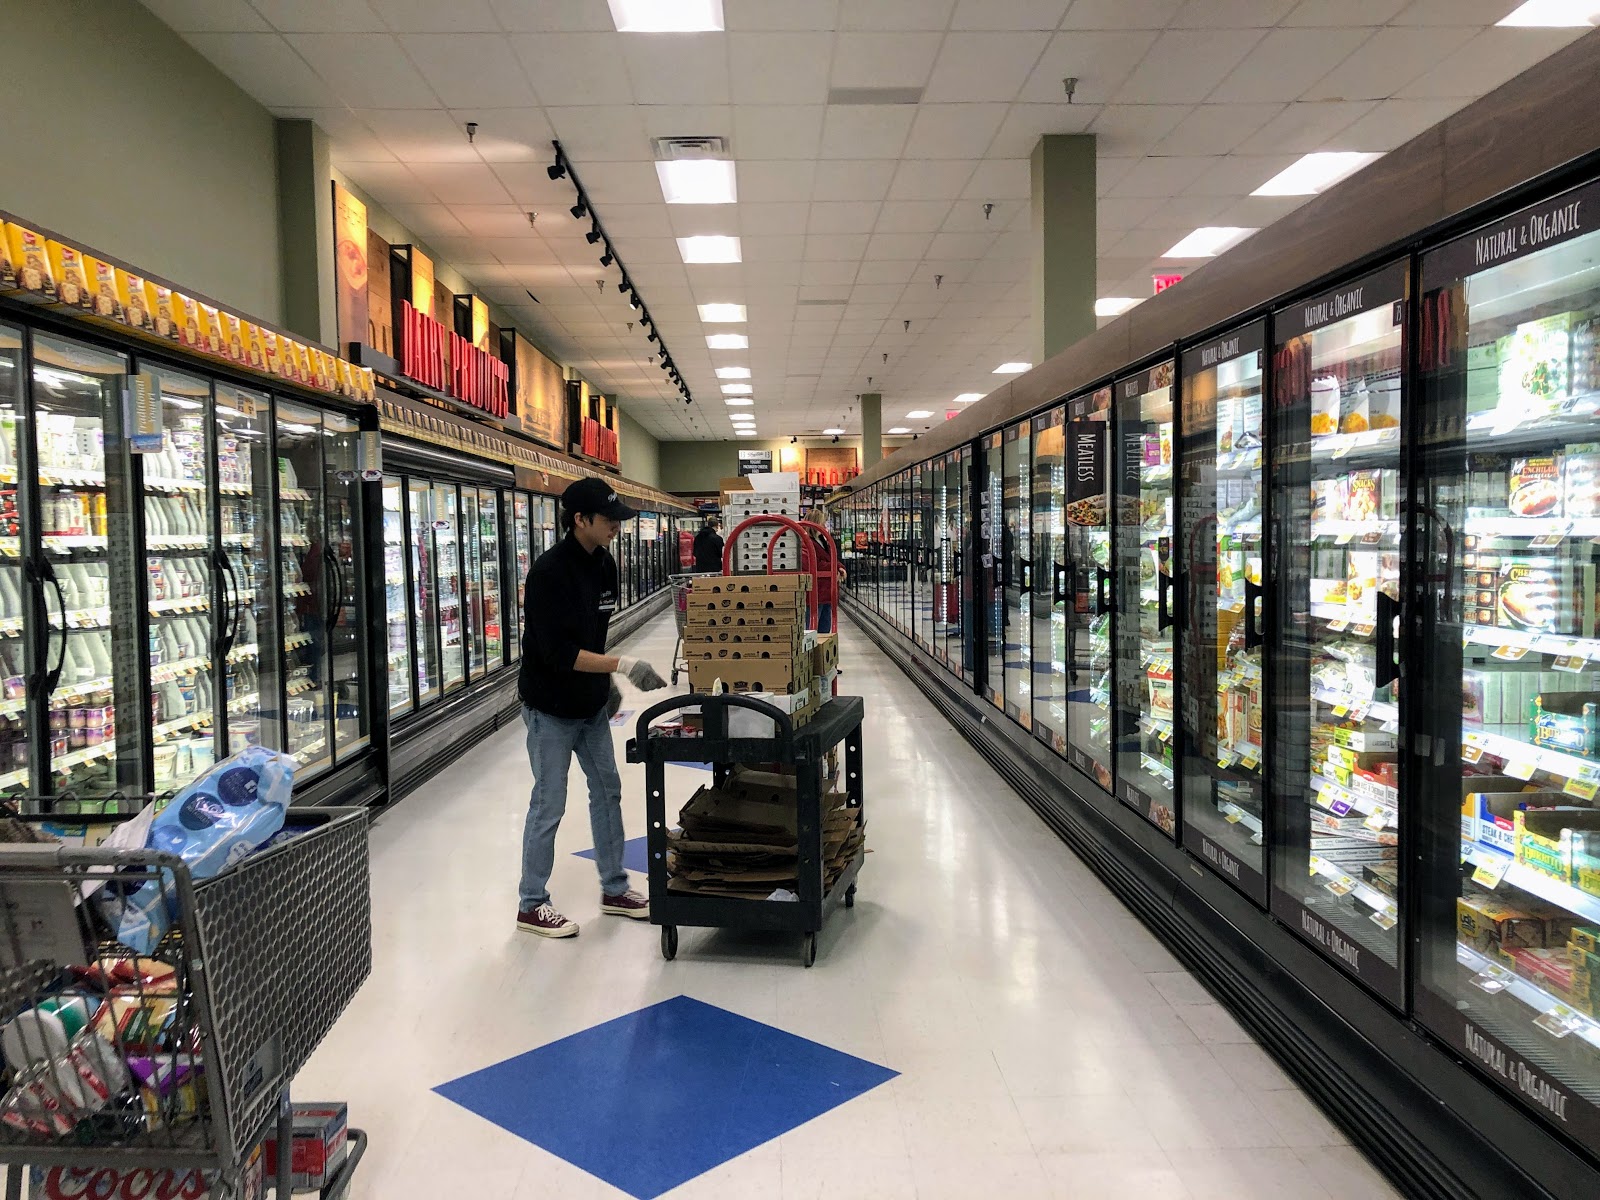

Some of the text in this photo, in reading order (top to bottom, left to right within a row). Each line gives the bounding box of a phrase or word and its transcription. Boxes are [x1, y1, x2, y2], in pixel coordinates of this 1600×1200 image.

[1475, 201, 1581, 266] NATURAL & ORGANIC
[1304, 302, 1329, 328] NATURAL
[1334, 287, 1364, 317] ORGANIC
[400, 299, 510, 420] DAIRY PRODUCTS
[135, 379, 147, 435] Traditional
[1077, 433, 1097, 483] MEATLESS
[1482, 824, 1497, 839] STEAK
[1503, 832, 1515, 846] CHE
[1465, 1023, 1508, 1079] NATURAL
[1518, 1061, 1568, 1122] ORGANIC
[45, 1164, 210, 1200] Coors
